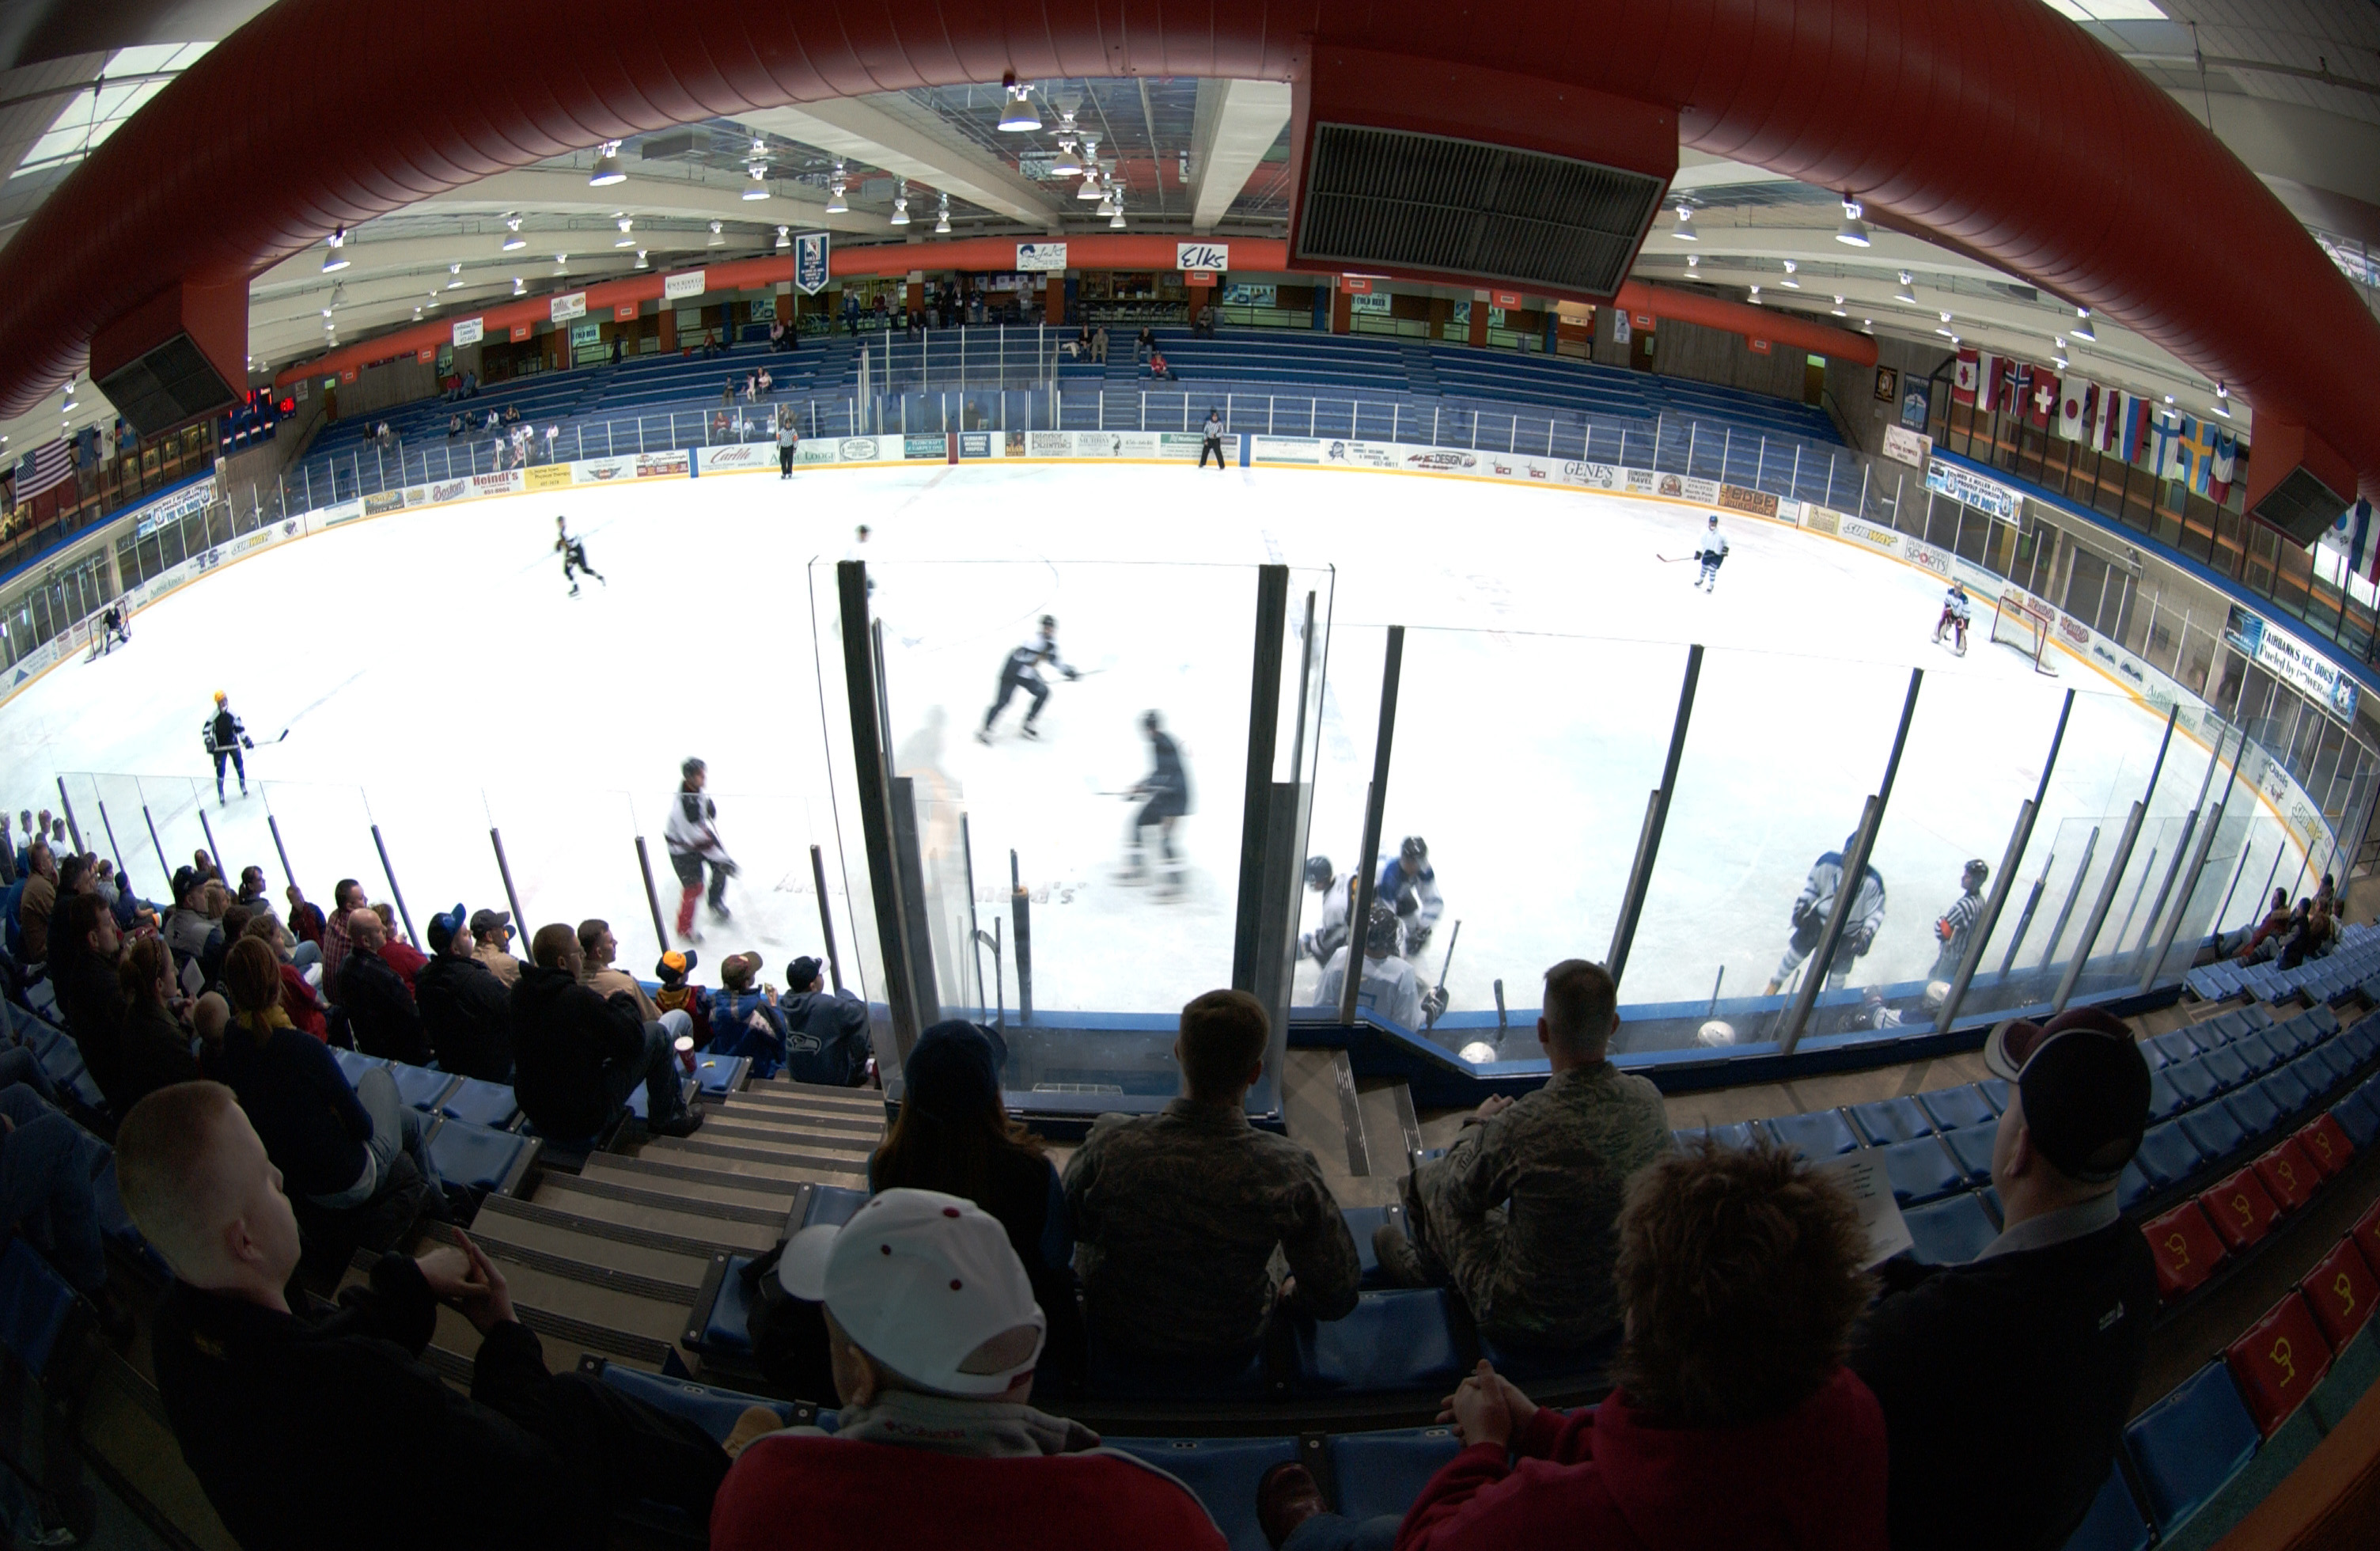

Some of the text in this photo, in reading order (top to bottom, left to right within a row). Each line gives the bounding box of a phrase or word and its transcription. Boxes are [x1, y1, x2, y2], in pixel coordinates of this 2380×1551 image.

[1181, 246, 1226, 267] Elks
[1356, 297, 1371, 305] COLD
[1371, 298, 1386, 307] BEER
[1434, 453, 1462, 466] DESIGN
[1495, 466, 1511, 475] GCI
[1530, 470, 1546, 479] GCI
[1564, 461, 1614, 480] GENE'S
[1627, 475, 1652, 484] TRAVEL
[433, 479, 465, 502] Boston's
[1731, 487, 1774, 508] EDGE
[1969, 492, 1980, 507] ICE
[1980, 497, 1997, 513] DOGS
[231, 531, 272, 556] SUBWAY
[1844, 522, 1898, 547] SUBWAY
[1908, 547, 1947, 573] SPORTS
[2259, 644, 2286, 669] Fueled
[2286, 662, 2296, 678] by
[2261, 628, 2334, 684] FAIRBANKS ICE DOGS
[2147, 684, 2172, 709] ALPINE
[2268, 762, 2288, 788] Oasis
